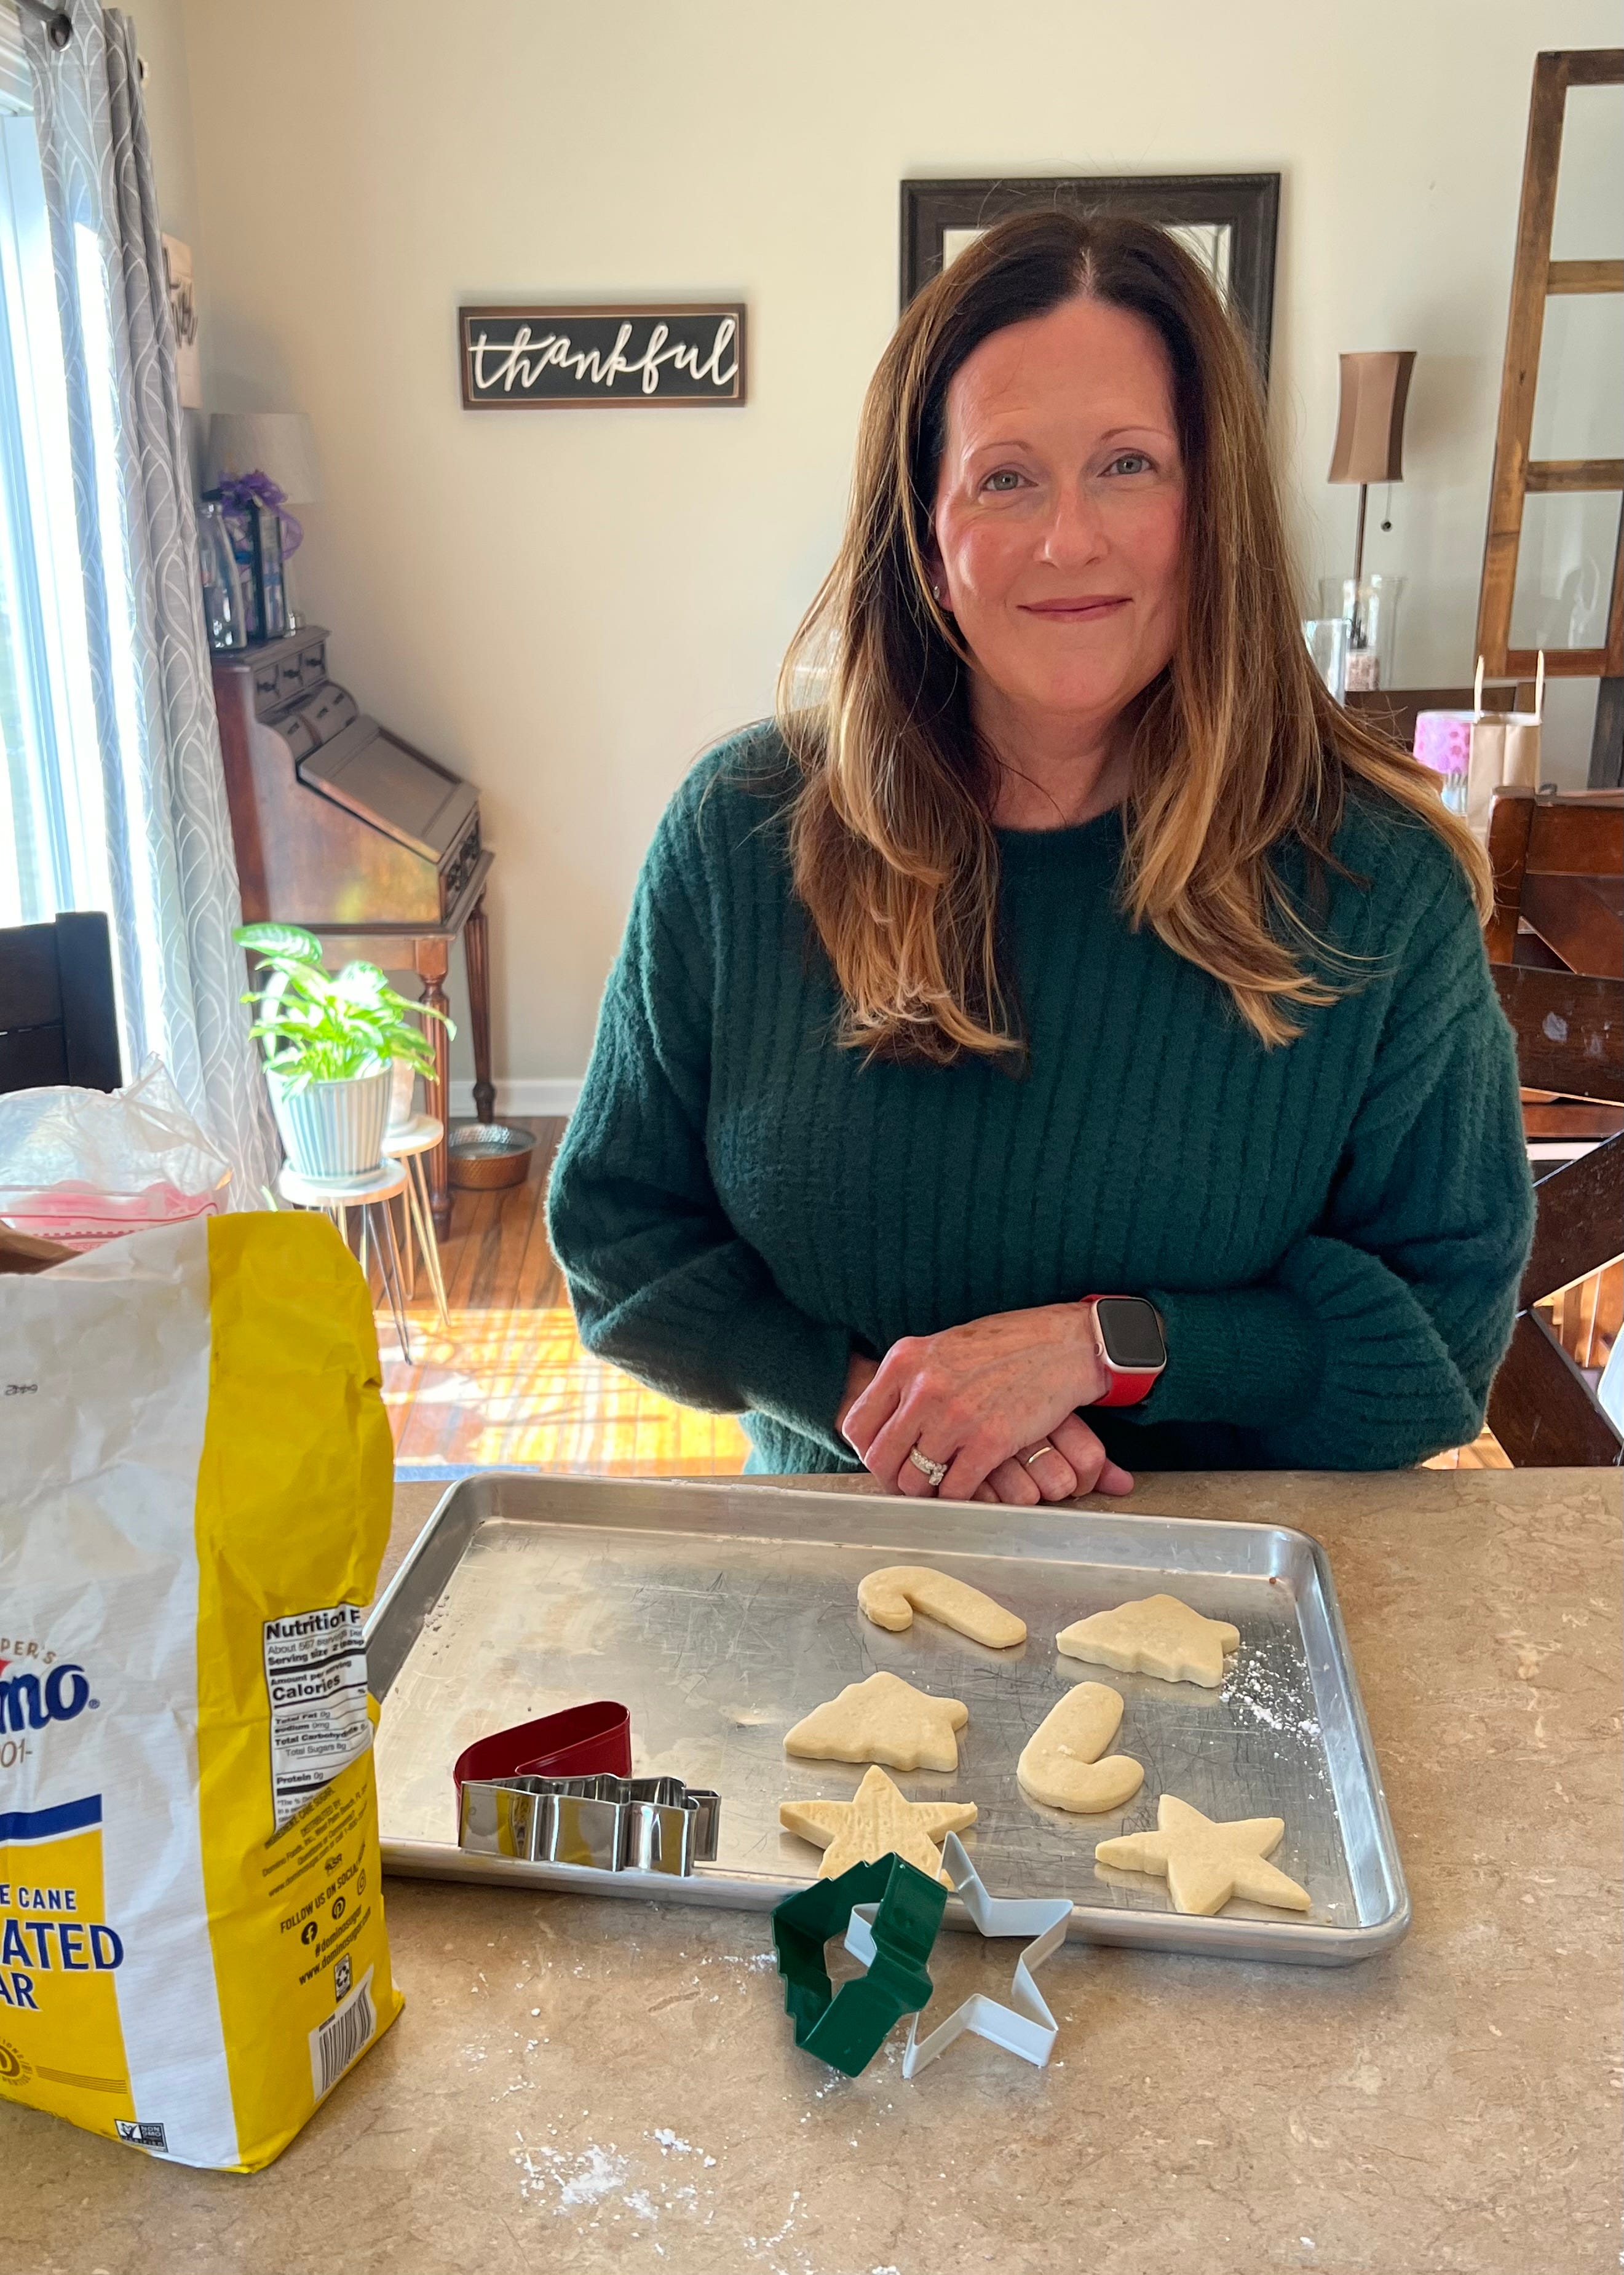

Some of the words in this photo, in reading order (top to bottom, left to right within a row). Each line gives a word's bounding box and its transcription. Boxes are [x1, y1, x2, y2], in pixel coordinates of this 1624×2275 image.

[468, 317, 738, 394] thankful
[268, 1643, 296, 1655] About
[271, 1674, 307, 1686] Amount
[272, 1674, 340, 1701] Calories
[275, 1735, 299, 1746] Total
[286, 1747, 305, 1757] Total
[307, 1743, 335, 1753] Sugars
[277, 1773, 311, 1784] Protein
[19, 1886, 76, 1910] CANE
[280, 1901, 314, 1934] FOLLOW
[315, 1892, 326, 1909] US
[326, 1881, 337, 1900] ON
[2, 1919, 124, 1969] ATED
